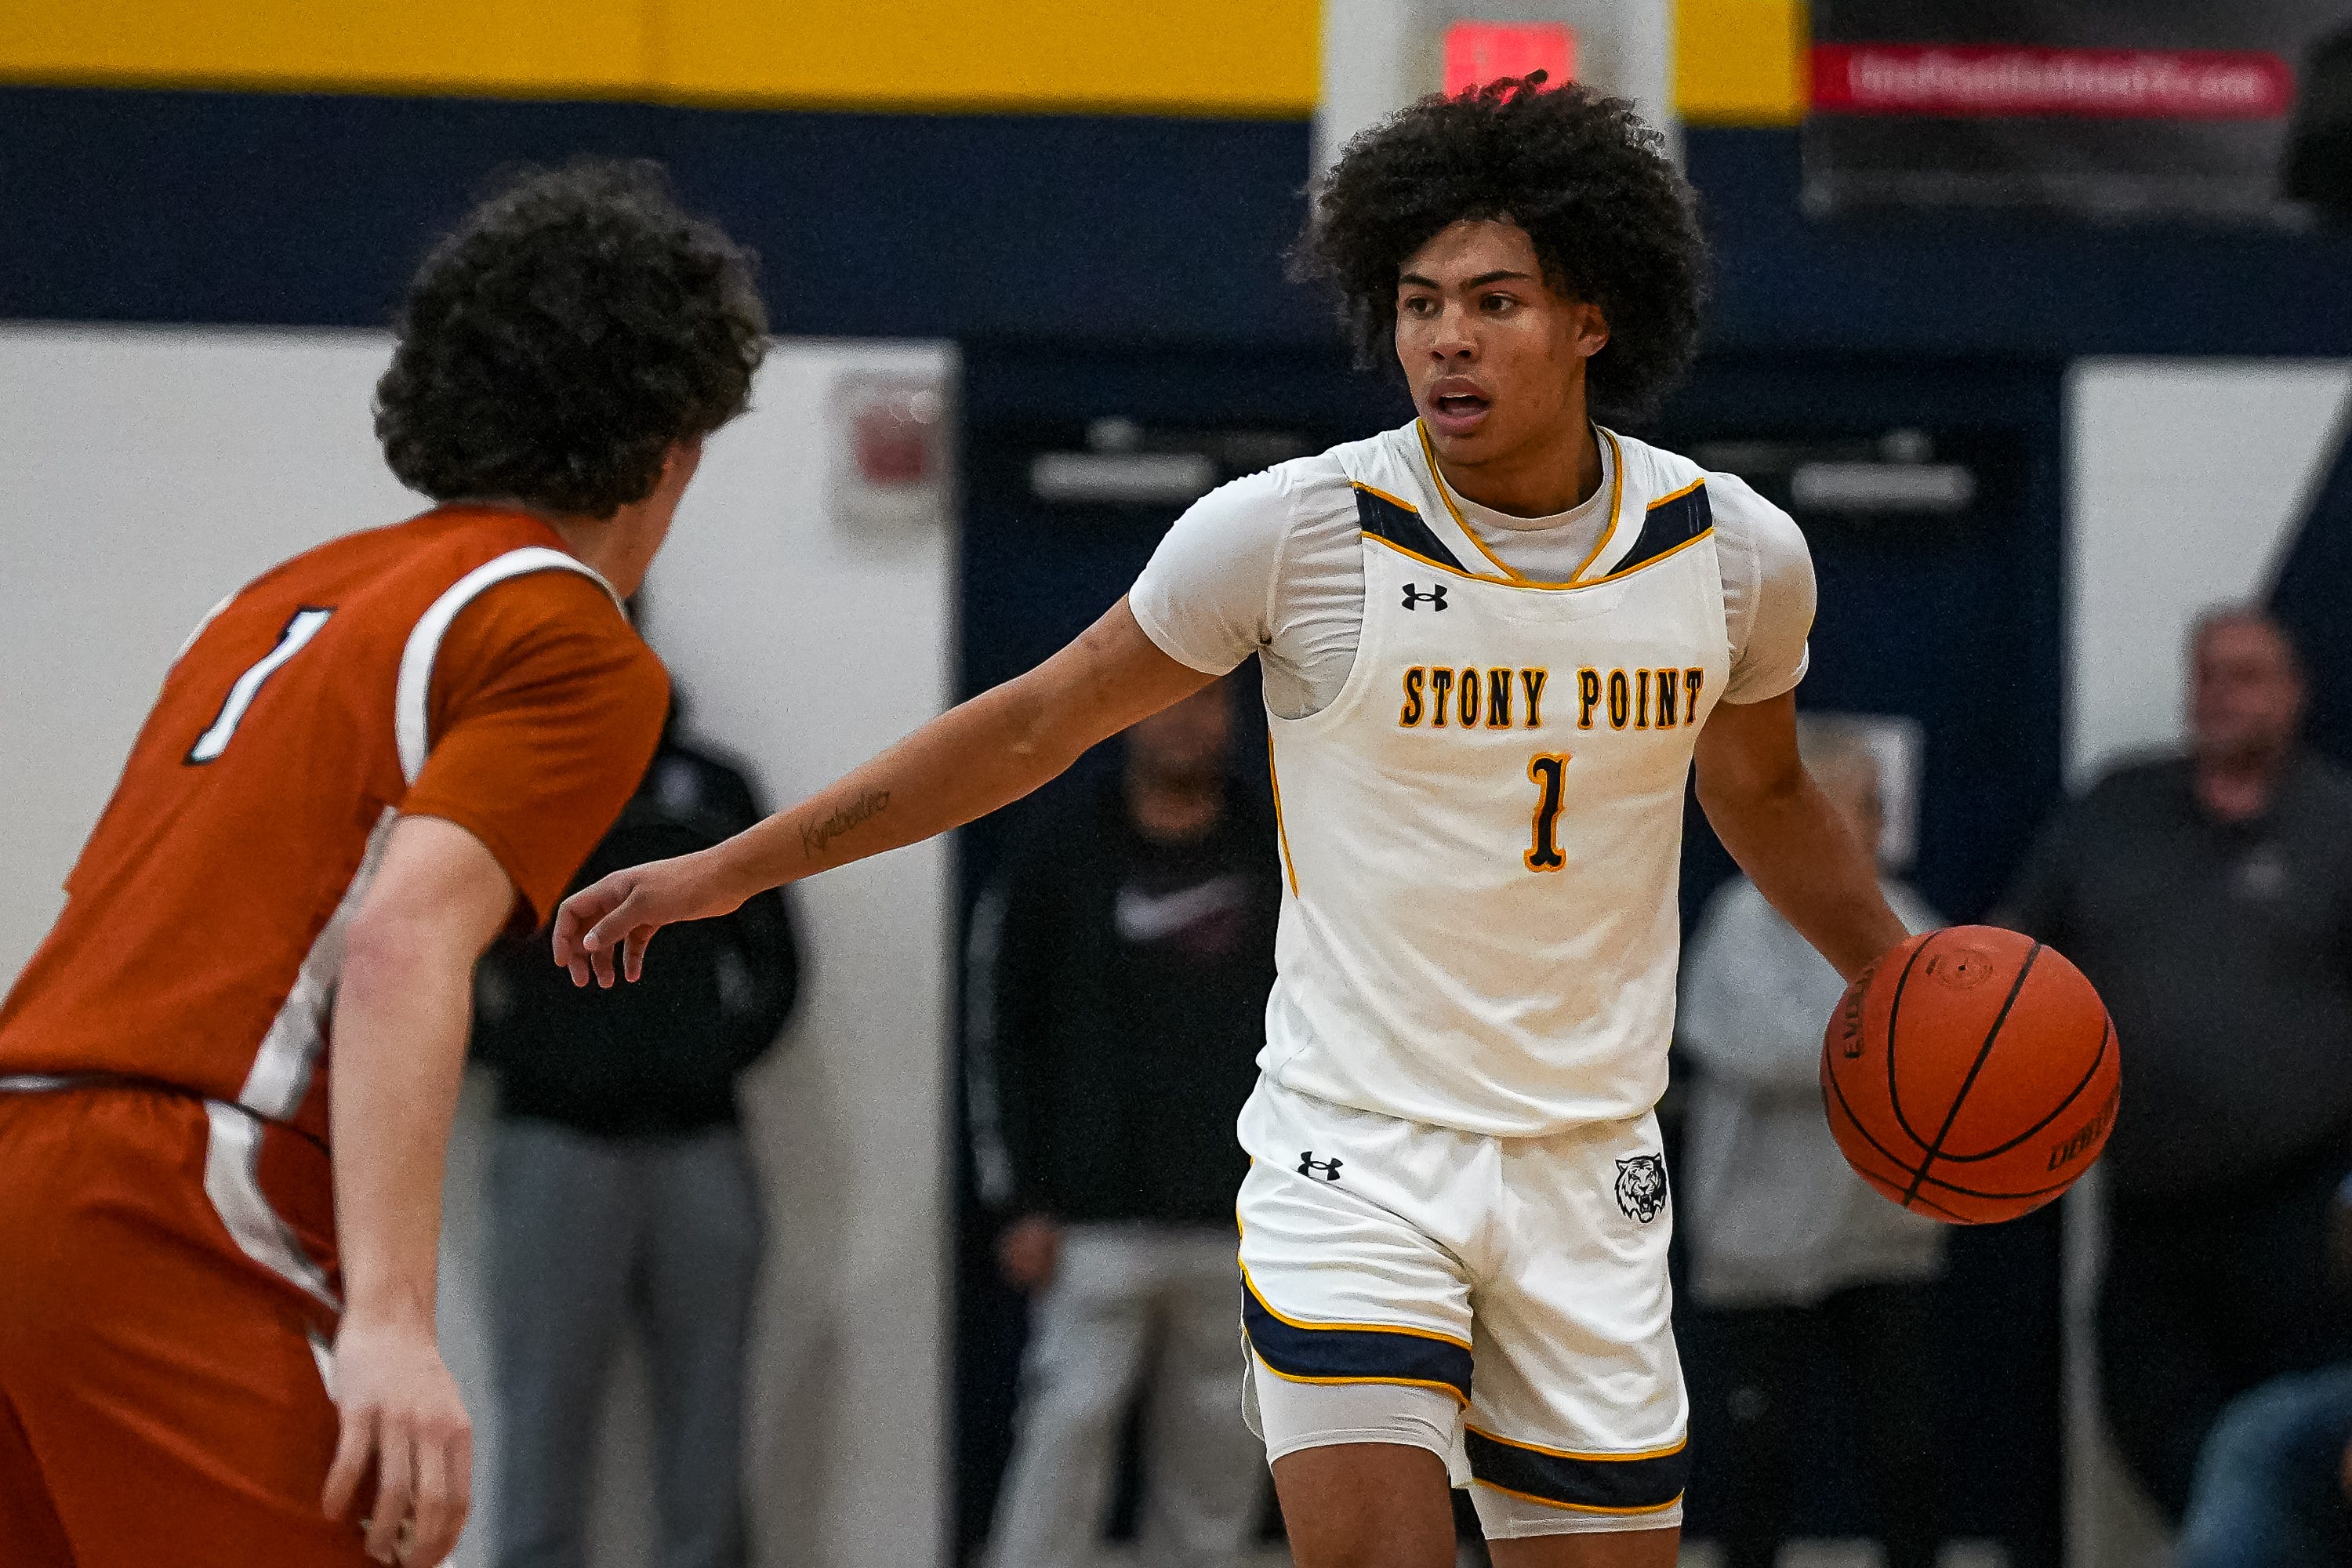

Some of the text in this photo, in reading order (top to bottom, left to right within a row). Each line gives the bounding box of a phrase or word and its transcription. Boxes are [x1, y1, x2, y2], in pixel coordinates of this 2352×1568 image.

[181, 604, 339, 768] 1
[1399, 666, 1704, 731] STONY POINT
[1523, 751, 1572, 873] 1
